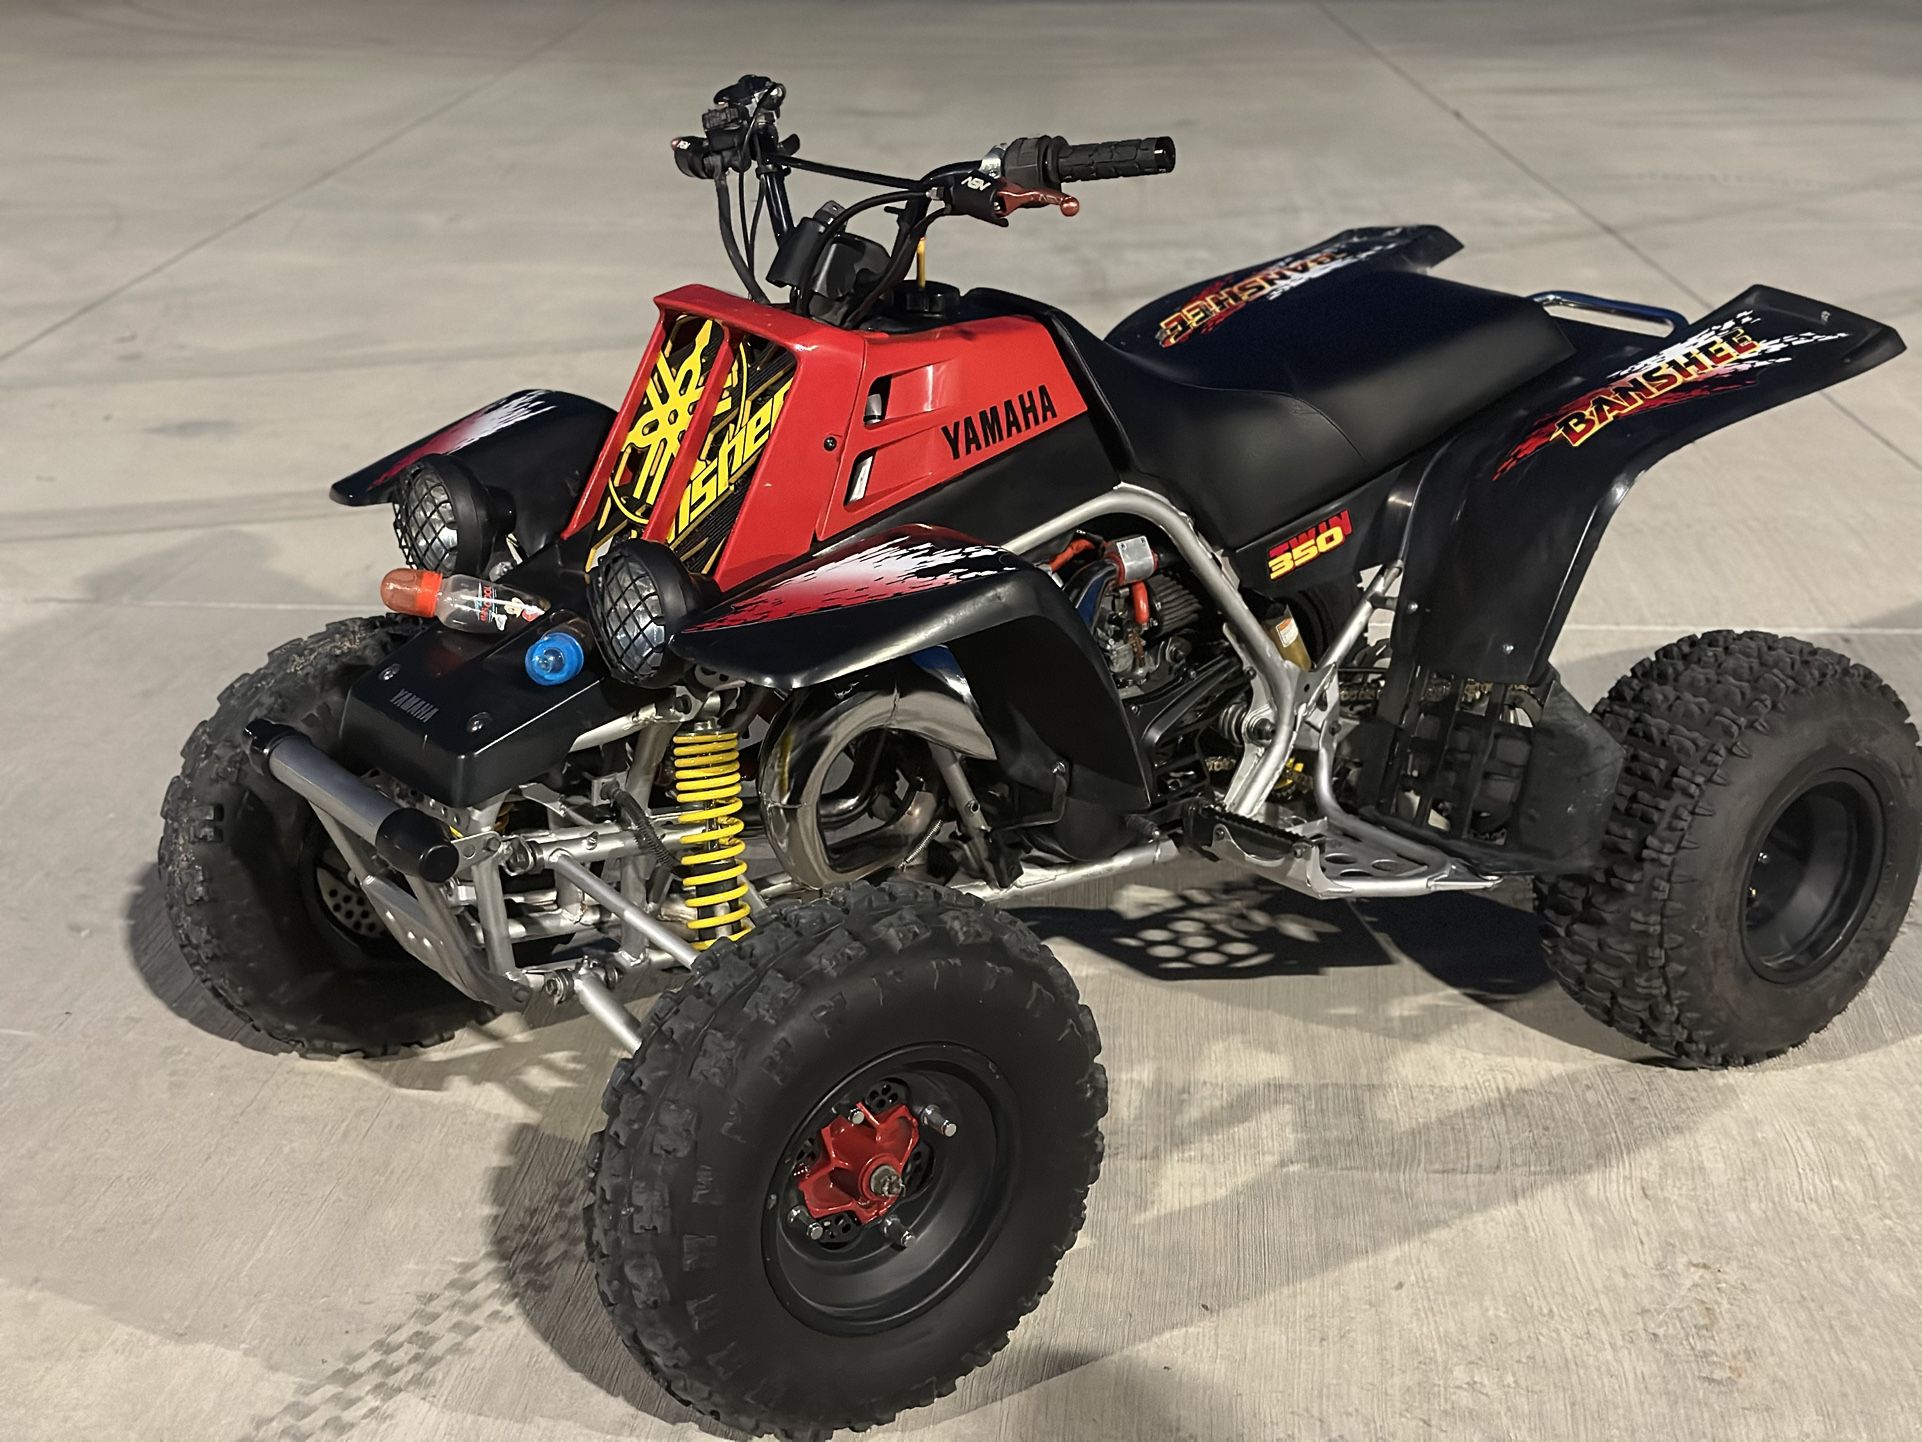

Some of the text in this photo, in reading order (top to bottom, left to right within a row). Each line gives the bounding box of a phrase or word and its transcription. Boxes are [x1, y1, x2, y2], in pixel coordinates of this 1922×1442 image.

[1158, 251, 1346, 347] BANSHEE
[940, 384, 1058, 461] YAMAHA
[1550, 326, 1761, 447] BANSHEE
[1267, 525, 1345, 581] 350
[389, 688, 440, 724] YAMAHA
